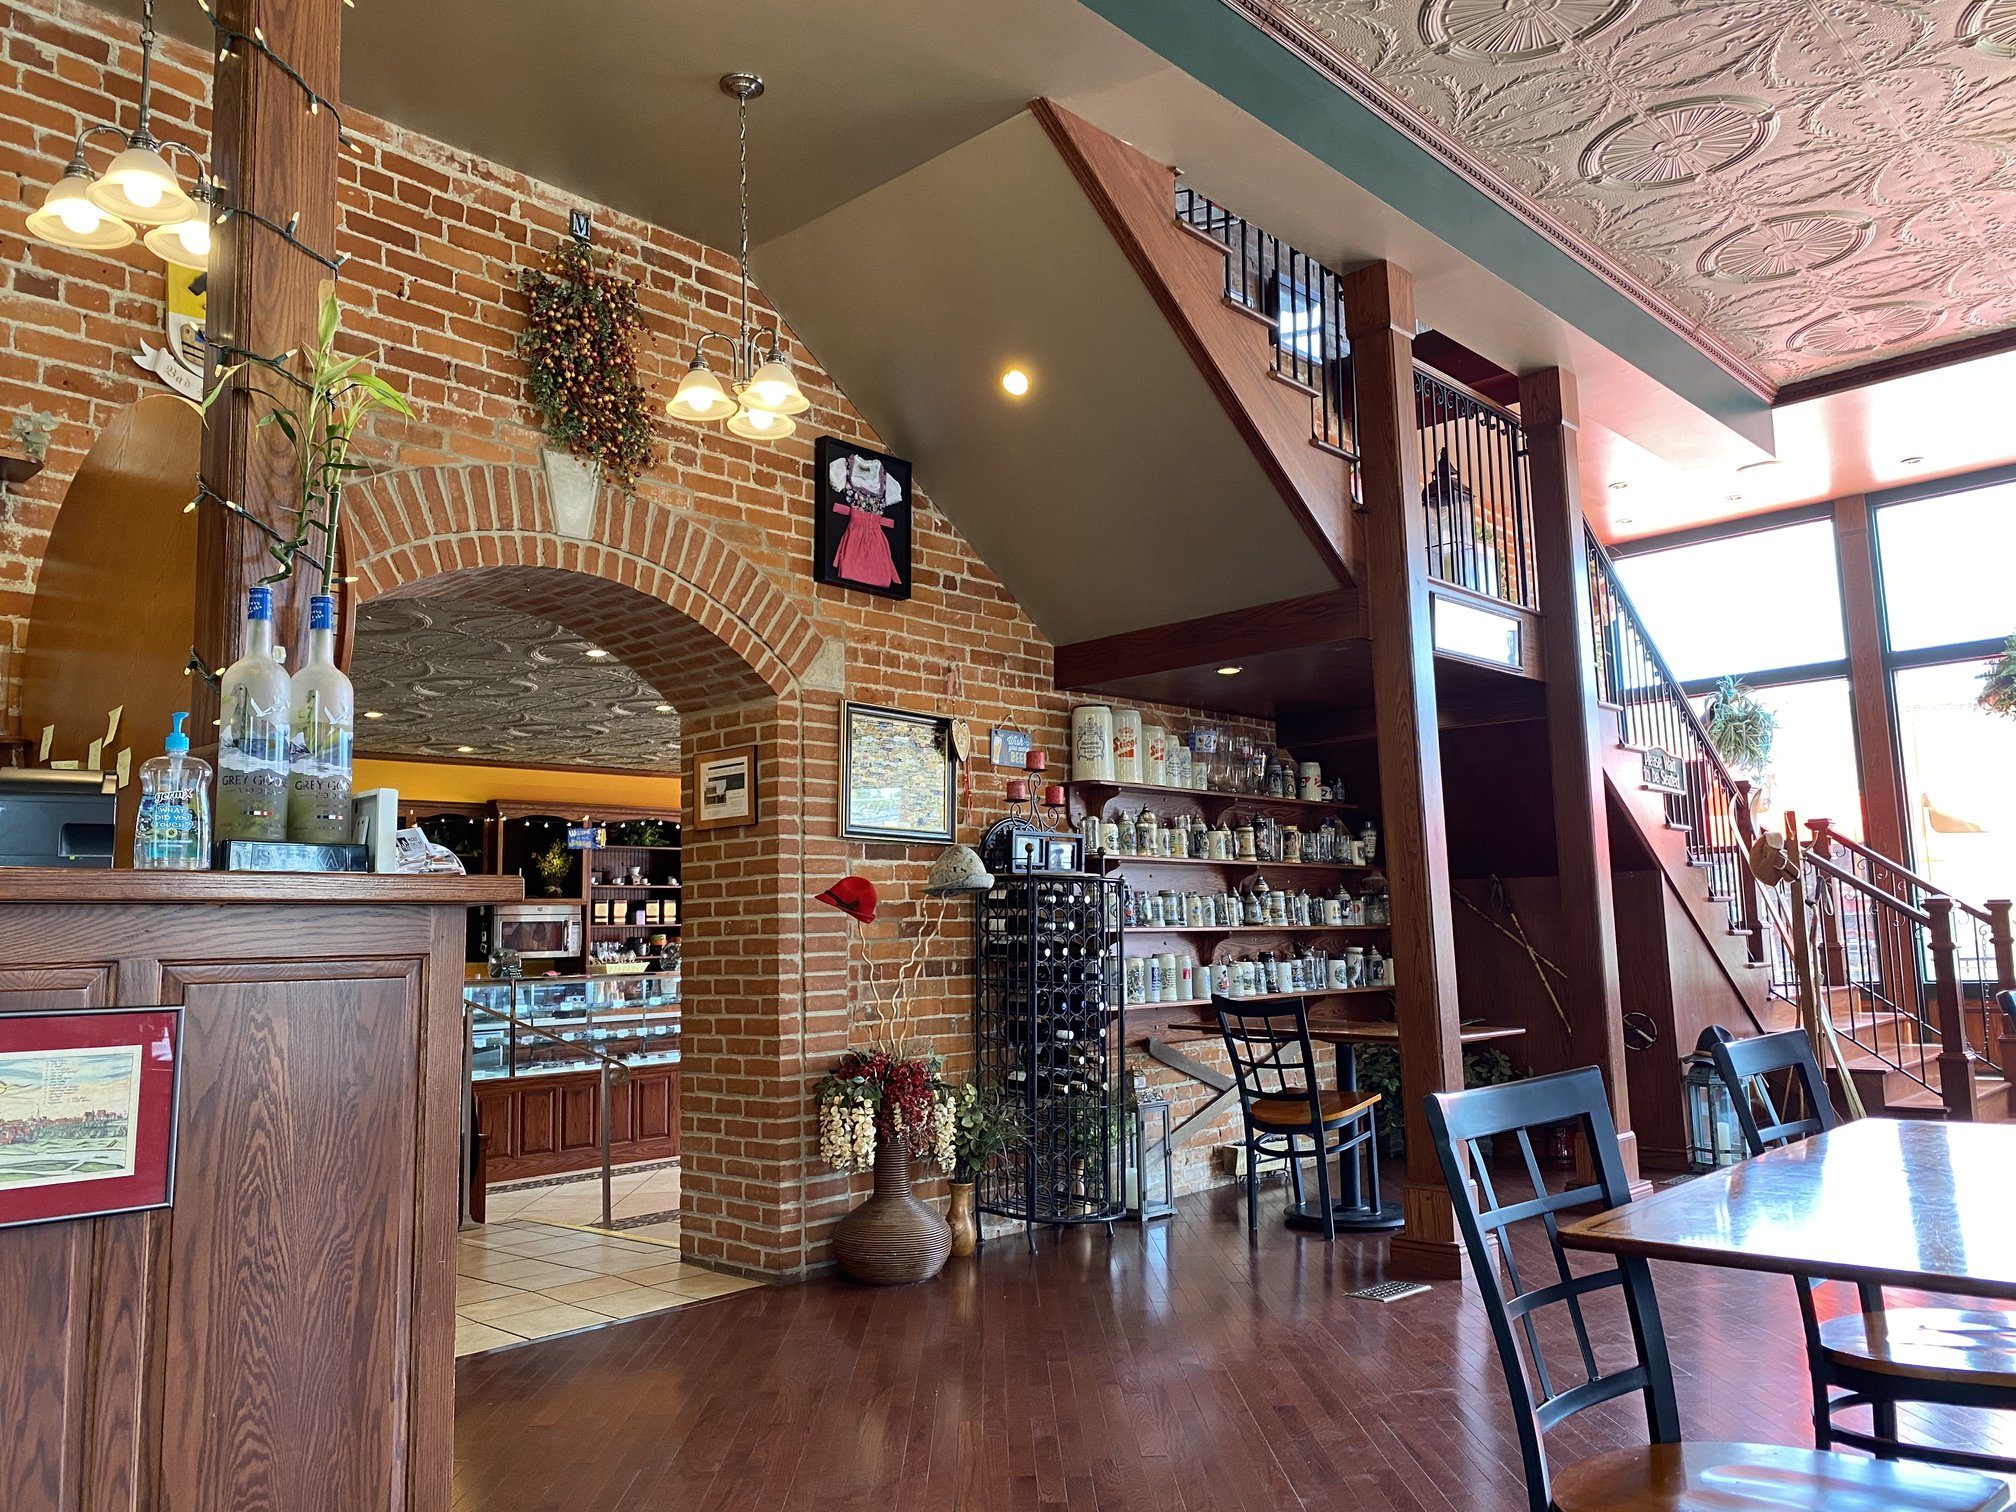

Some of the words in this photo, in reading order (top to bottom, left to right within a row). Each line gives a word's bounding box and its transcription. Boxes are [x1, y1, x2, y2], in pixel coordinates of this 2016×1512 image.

[1661, 755, 1676, 772] Wait
[222, 775, 249, 786] GREY
[1651, 768, 1660, 783] be
[1660, 770, 1680, 789] Seated
[295, 780, 322, 790] GREY
[158, 805, 186, 814] WHAT
[155, 821, 191, 829] TOUCH?
